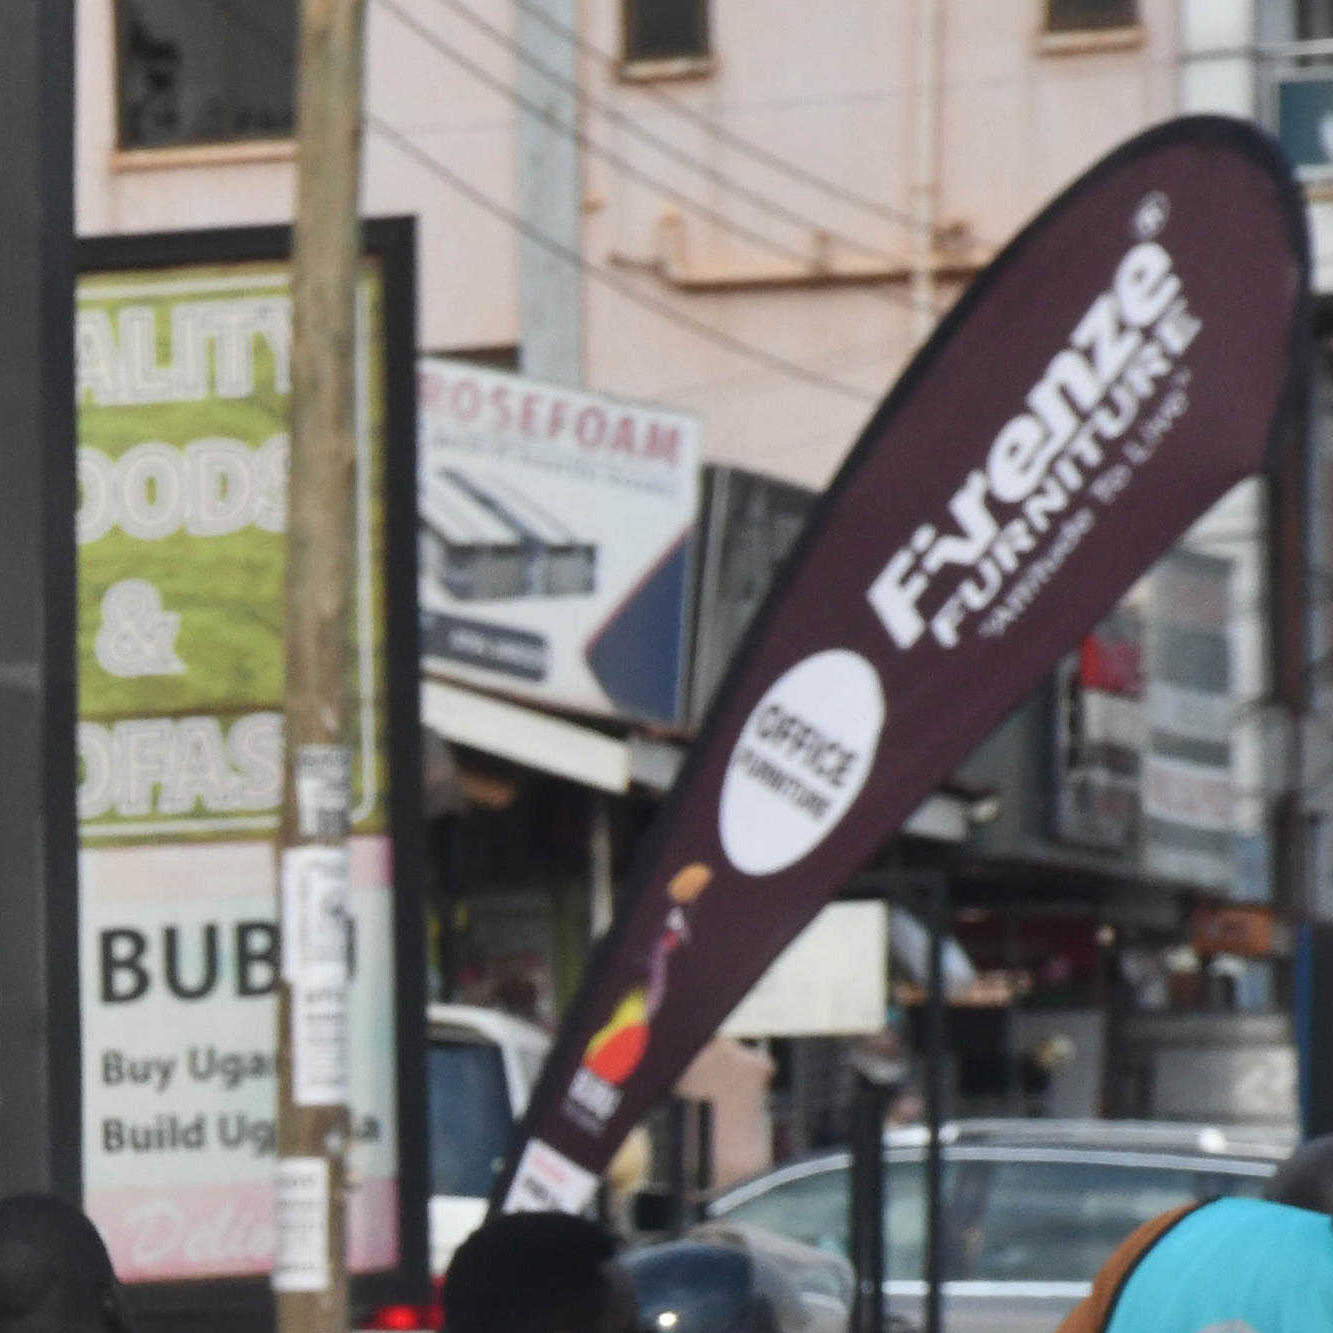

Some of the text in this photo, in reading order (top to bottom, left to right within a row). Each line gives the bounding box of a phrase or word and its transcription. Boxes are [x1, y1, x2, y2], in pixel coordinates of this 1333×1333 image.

[865, 241, 1183, 651] Firenze
[932, 299, 1204, 650] FURNITURE
[76, 710, 286, 820] OFAS
[754, 704, 859, 790] OFFICE
[102, 1045, 277, 1094] Buy Uga
[102, 1111, 206, 1153] Build
